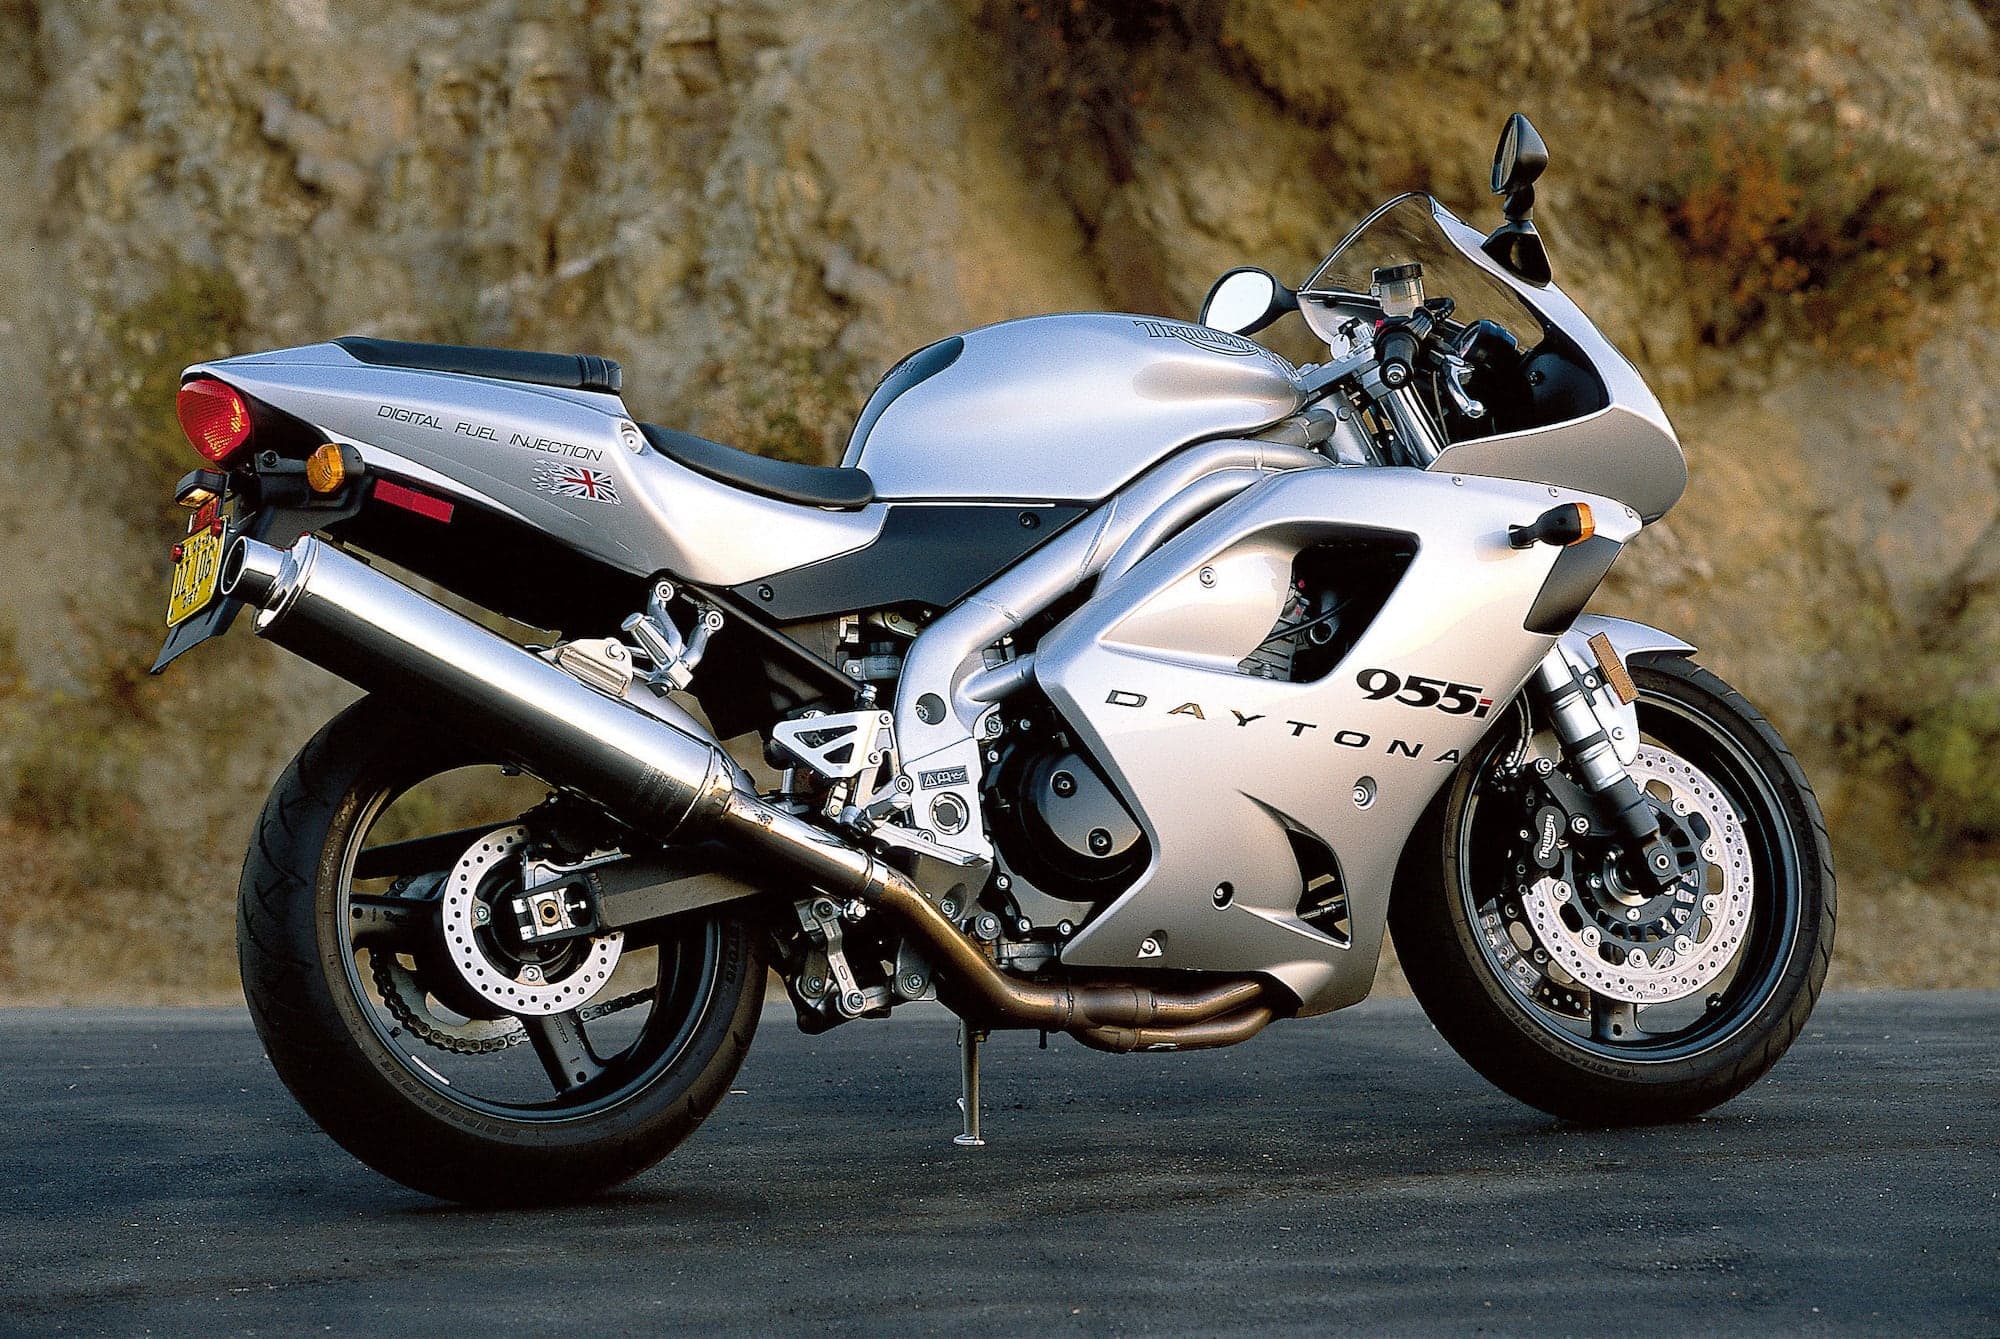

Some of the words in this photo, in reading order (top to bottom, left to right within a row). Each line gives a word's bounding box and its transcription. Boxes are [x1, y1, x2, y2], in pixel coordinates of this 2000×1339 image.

[377, 405, 443, 430] DIGITAL
[454, 422, 499, 442] FUEL
[509, 433, 603, 462] INJECTION
[1356, 668, 1494, 719] 955i
[1105, 689, 1461, 764] DAYTONA
[1539, 813, 1556, 859] TRIUMPH
